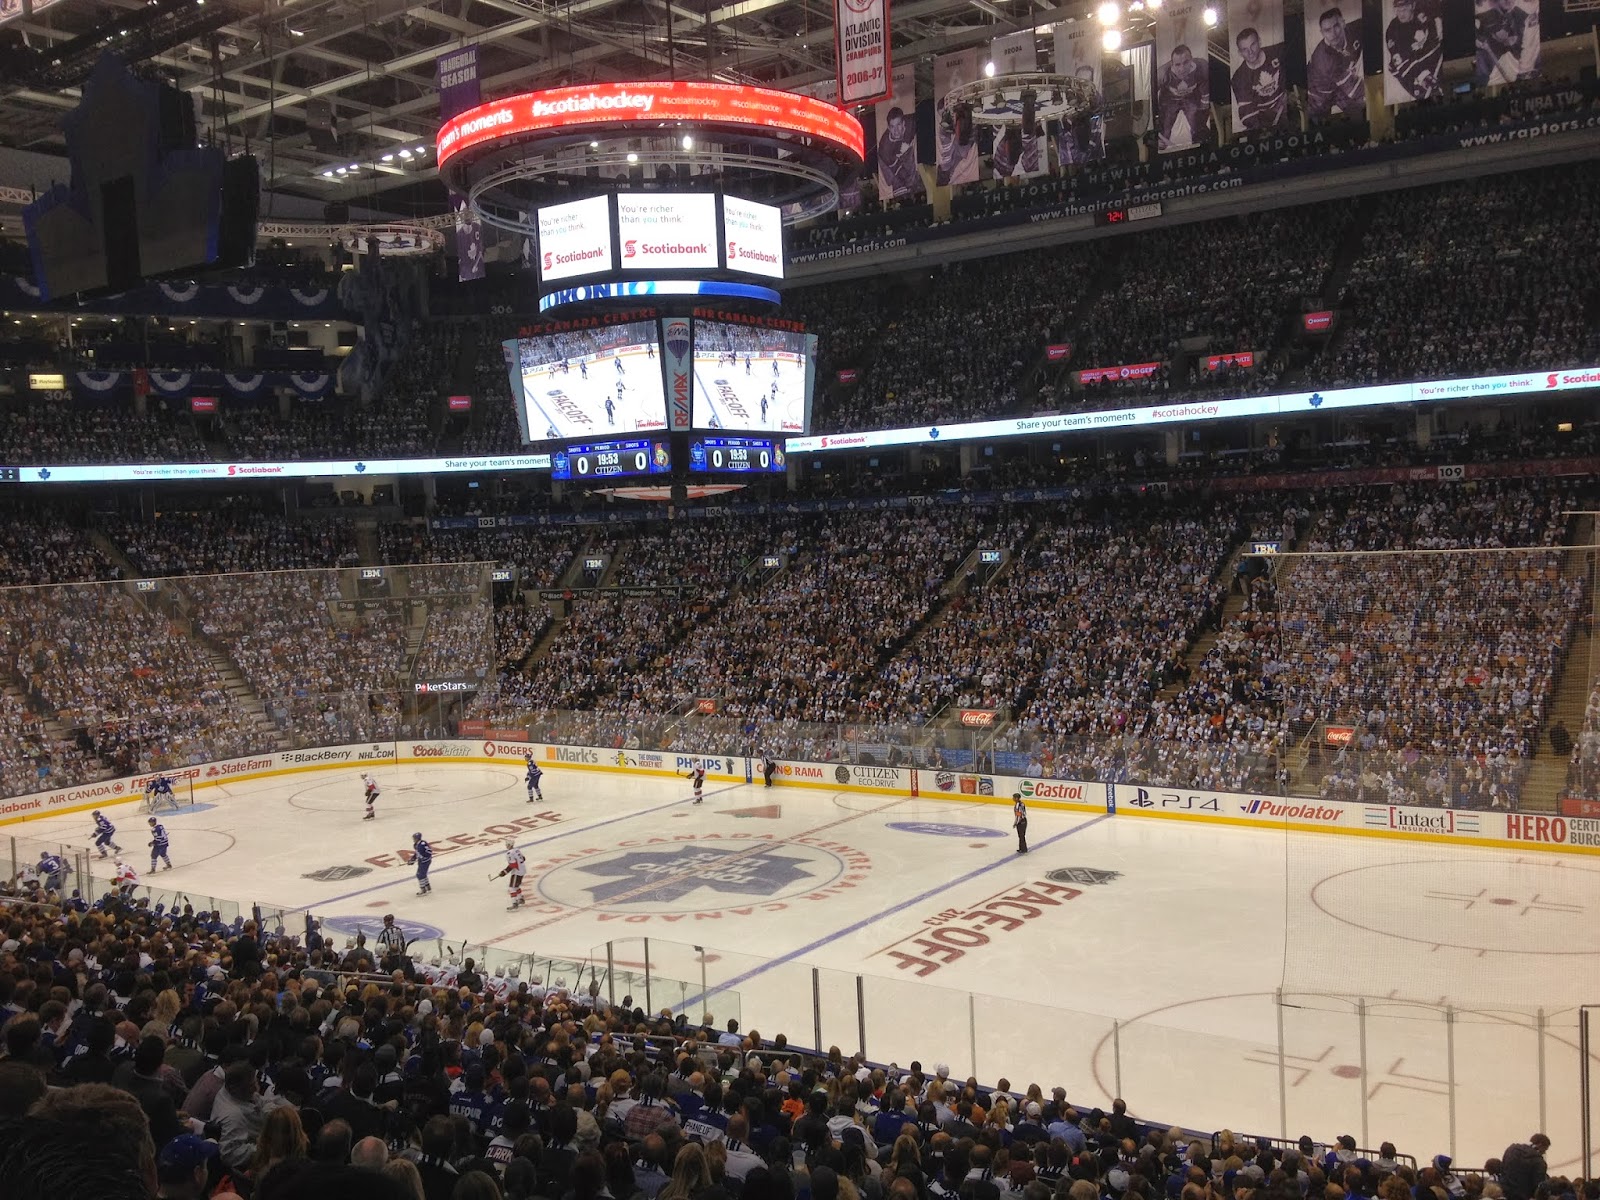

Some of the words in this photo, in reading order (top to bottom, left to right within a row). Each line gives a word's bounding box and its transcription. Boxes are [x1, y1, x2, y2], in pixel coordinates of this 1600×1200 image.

[845, 18, 880, 37] ATLANTIC
[845, 32, 881, 51] DIVISION
[846, 46, 882, 62] CHAMPIONS
[440, 50, 476, 72] INAUGURAL
[440, 66, 477, 89] SEASON
[847, 67, 882, 86] 2006-07
[532, 90, 654, 117] #scotiahockey
[461, 107, 514, 137] moments
[984, 191, 1010, 204] THE
[1020, 179, 1078, 198] FOSTER
[1089, 163, 1150, 184] HEWITT
[1162, 152, 1218, 171] MEDIA
[1230, 132, 1324, 158] GONDOLA
[620, 204, 648, 214] You're
[649, 204, 675, 213] richer
[621, 215, 641, 223] than
[643, 216, 658, 225] you
[555, 247, 604, 264] Scotiabank
[642, 243, 708, 255] Scotiabank
[738, 247, 778, 263] Scotiabank
[789, 237, 907, 264] www.mapleleafs.com
[545, 317, 599, 332] CANADA
[603, 308, 657, 324] CENTRE
[717, 310, 763, 325] CANADA
[766, 319, 806, 332] CENTRE
[1419, 387, 1445, 395] You're
[1447, 384, 1469, 393] richer
[1471, 382, 1490, 391] than
[44, 391, 72, 401] 304
[674, 372, 688, 427] RE/MAX
[1016, 421, 1040, 430] Share
[1042, 420, 1061, 429] your
[1063, 415, 1092, 425] team's
[1093, 412, 1136, 423] moments
[1152, 405, 1219, 418] #scotiahockey
[830, 436, 866, 445] Scotiabank
[596, 453, 619, 466] 19:53
[712, 449, 723, 468] 0
[729, 448, 748, 460] 19:53
[760, 450, 769, 468] 0
[445, 460, 468, 468] Share
[469, 460, 487, 468] your
[490, 458, 515, 466] team's
[577, 456, 589, 474] 0
[635, 452, 647, 470] 0
[727, 461, 751, 470] CITIZEN
[132, 468, 153, 476] You're
[188, 468, 200, 476] you
[238, 466, 282, 475] Scotiabank
[594, 465, 623, 475] CITIZEN
[1440, 468, 1463, 477] 109
[706, 508, 721, 516] 106
[478, 518, 494, 527] 105
[1254, 544, 1277, 554] IBM
[764, 557, 779, 567] IBM
[980, 551, 999, 562] IBM
[586, 559, 603, 568] IBM
[363, 569, 381, 578] IBM
[492, 572, 510, 581] IBM
[137, 581, 156, 592] IBM
[294, 750, 351, 763] BlackBerry
[358, 750, 394, 760] NHL.COM
[412, 745, 443, 757] Coors
[442, 746, 472, 757] LIGHT
[497, 745, 534, 756] ROGERS
[556, 747, 599, 764] Mark's
[795, 766, 823, 778] RAMA
[853, 766, 900, 780] CITIZEN
[858, 777, 896, 788] ECO-DRIVE
[48, 793, 67, 805] AIR
[67, 787, 111, 802] CANADA
[1035, 782, 1083, 800] Castrol
[1161, 793, 1220, 812] PS4
[1257, 801, 1344, 821] Purolator
[1398, 811, 1447, 830] intact
[1398, 825, 1446, 834] INSURANCE
[1507, 814, 1566, 843] HERO
[922, 908, 966, 926] 2013
[887, 881, 1084, 978] FACE-OFF
